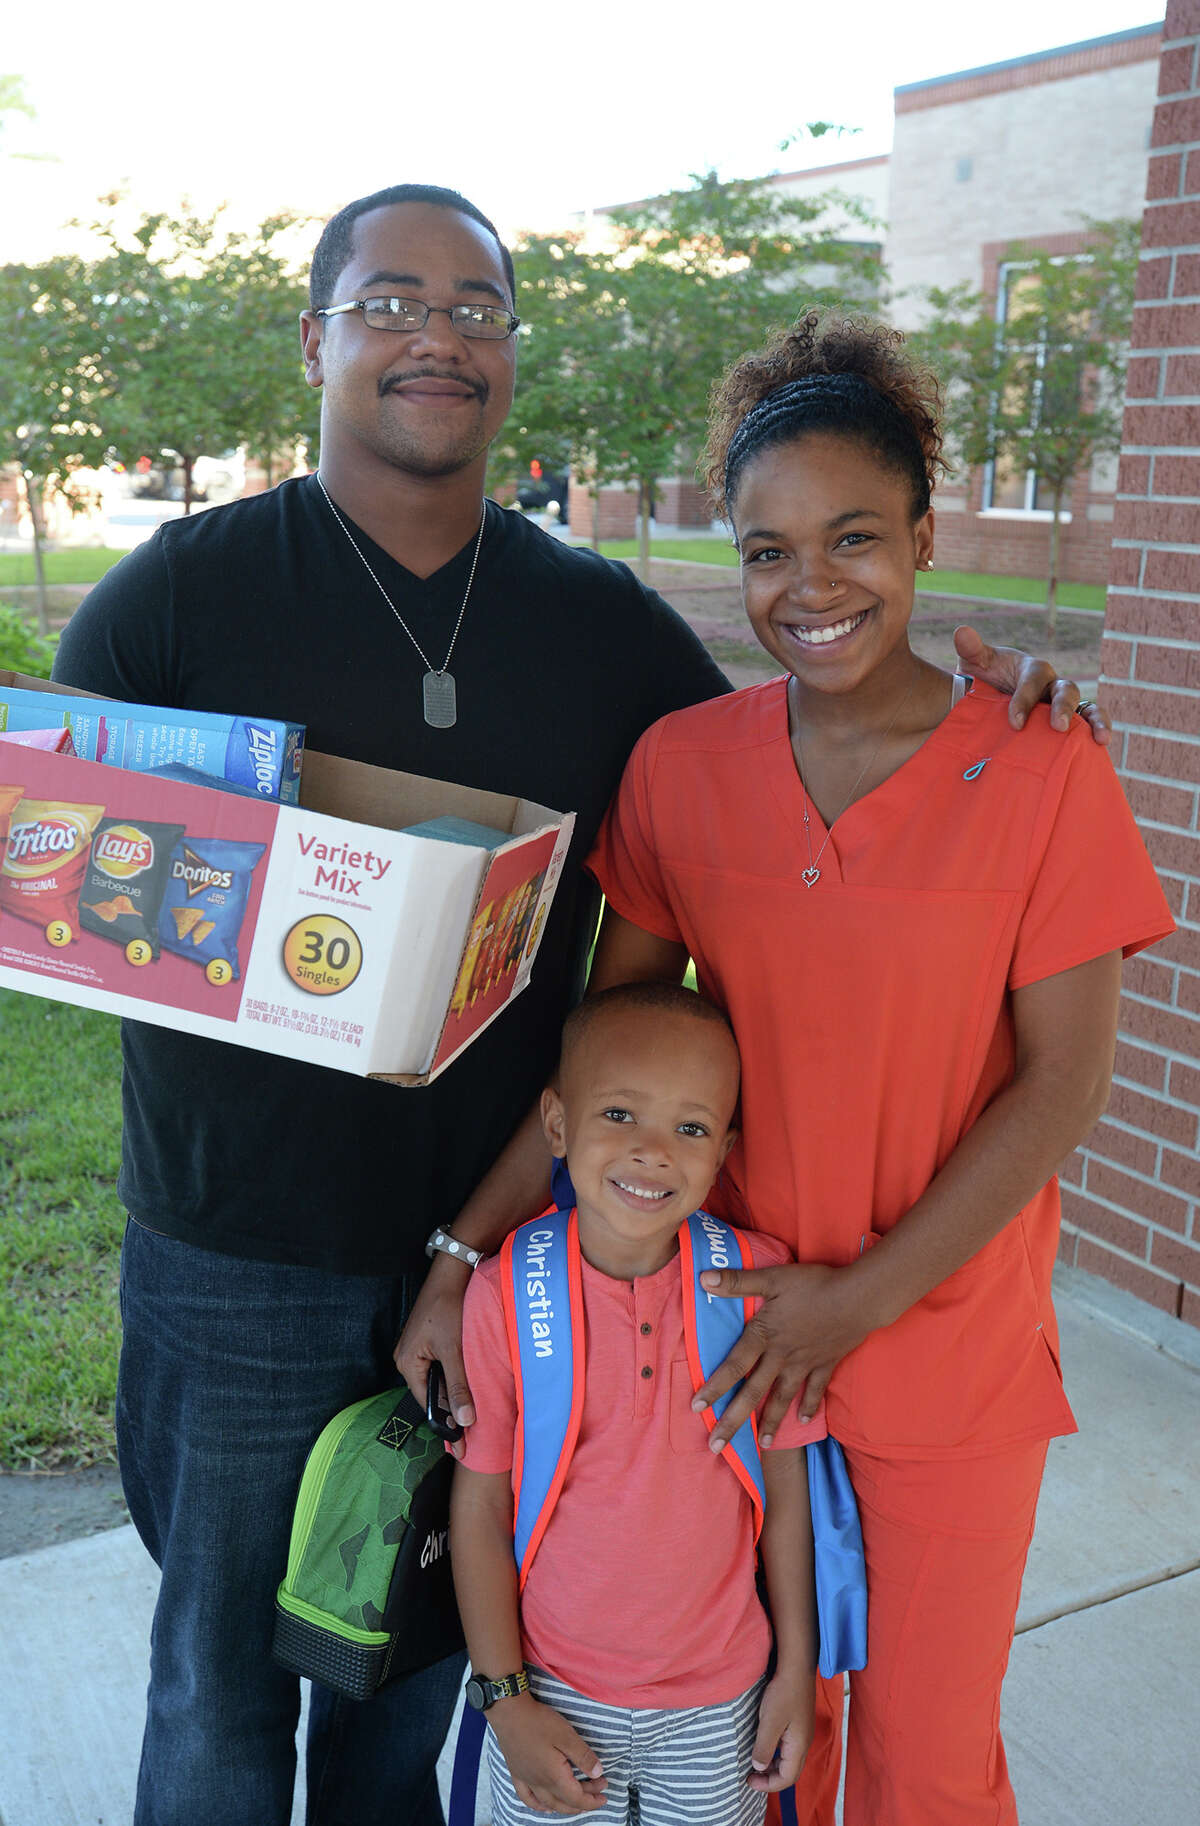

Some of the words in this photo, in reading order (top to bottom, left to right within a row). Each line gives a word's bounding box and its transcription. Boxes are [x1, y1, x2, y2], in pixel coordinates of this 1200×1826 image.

[135, 729, 144, 763] FREEZER
[188, 728, 199, 753] OPEN
[248, 722, 276, 794] Ziploc
[8, 821, 78, 860] Fritos
[96, 833, 149, 864] Lay's
[297, 832, 393, 881] Variety
[91, 875, 142, 897] Barbecue
[172, 860, 233, 889] Doritos
[313, 865, 363, 897] Mix
[53, 928, 64, 941] 3
[133, 947, 143, 960] 3
[297, 930, 351, 971] 30
[213, 967, 223, 980] 3
[295, 965, 341, 987] Singles
[526, 1230, 554, 1358] Christian
